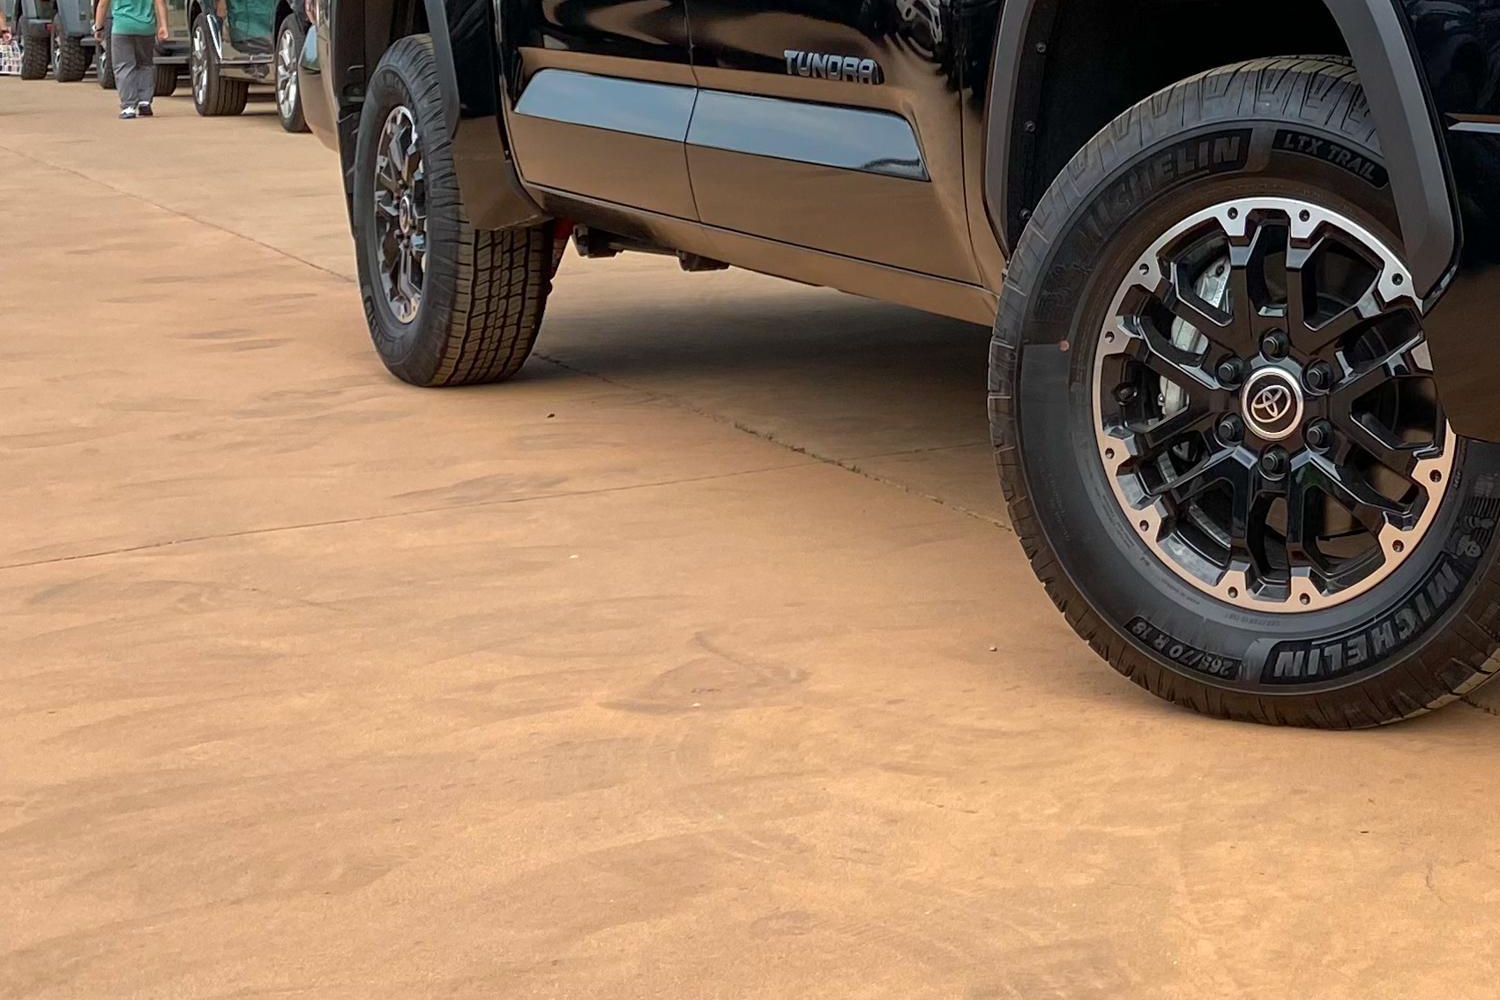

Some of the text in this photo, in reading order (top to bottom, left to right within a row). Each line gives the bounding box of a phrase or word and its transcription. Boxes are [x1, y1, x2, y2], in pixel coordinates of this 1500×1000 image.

[783, 49, 884, 86] TUNDRA
[1282, 132, 1376, 181] LTX TRAIL
[1272, 559, 1462, 679] MICHELIN
